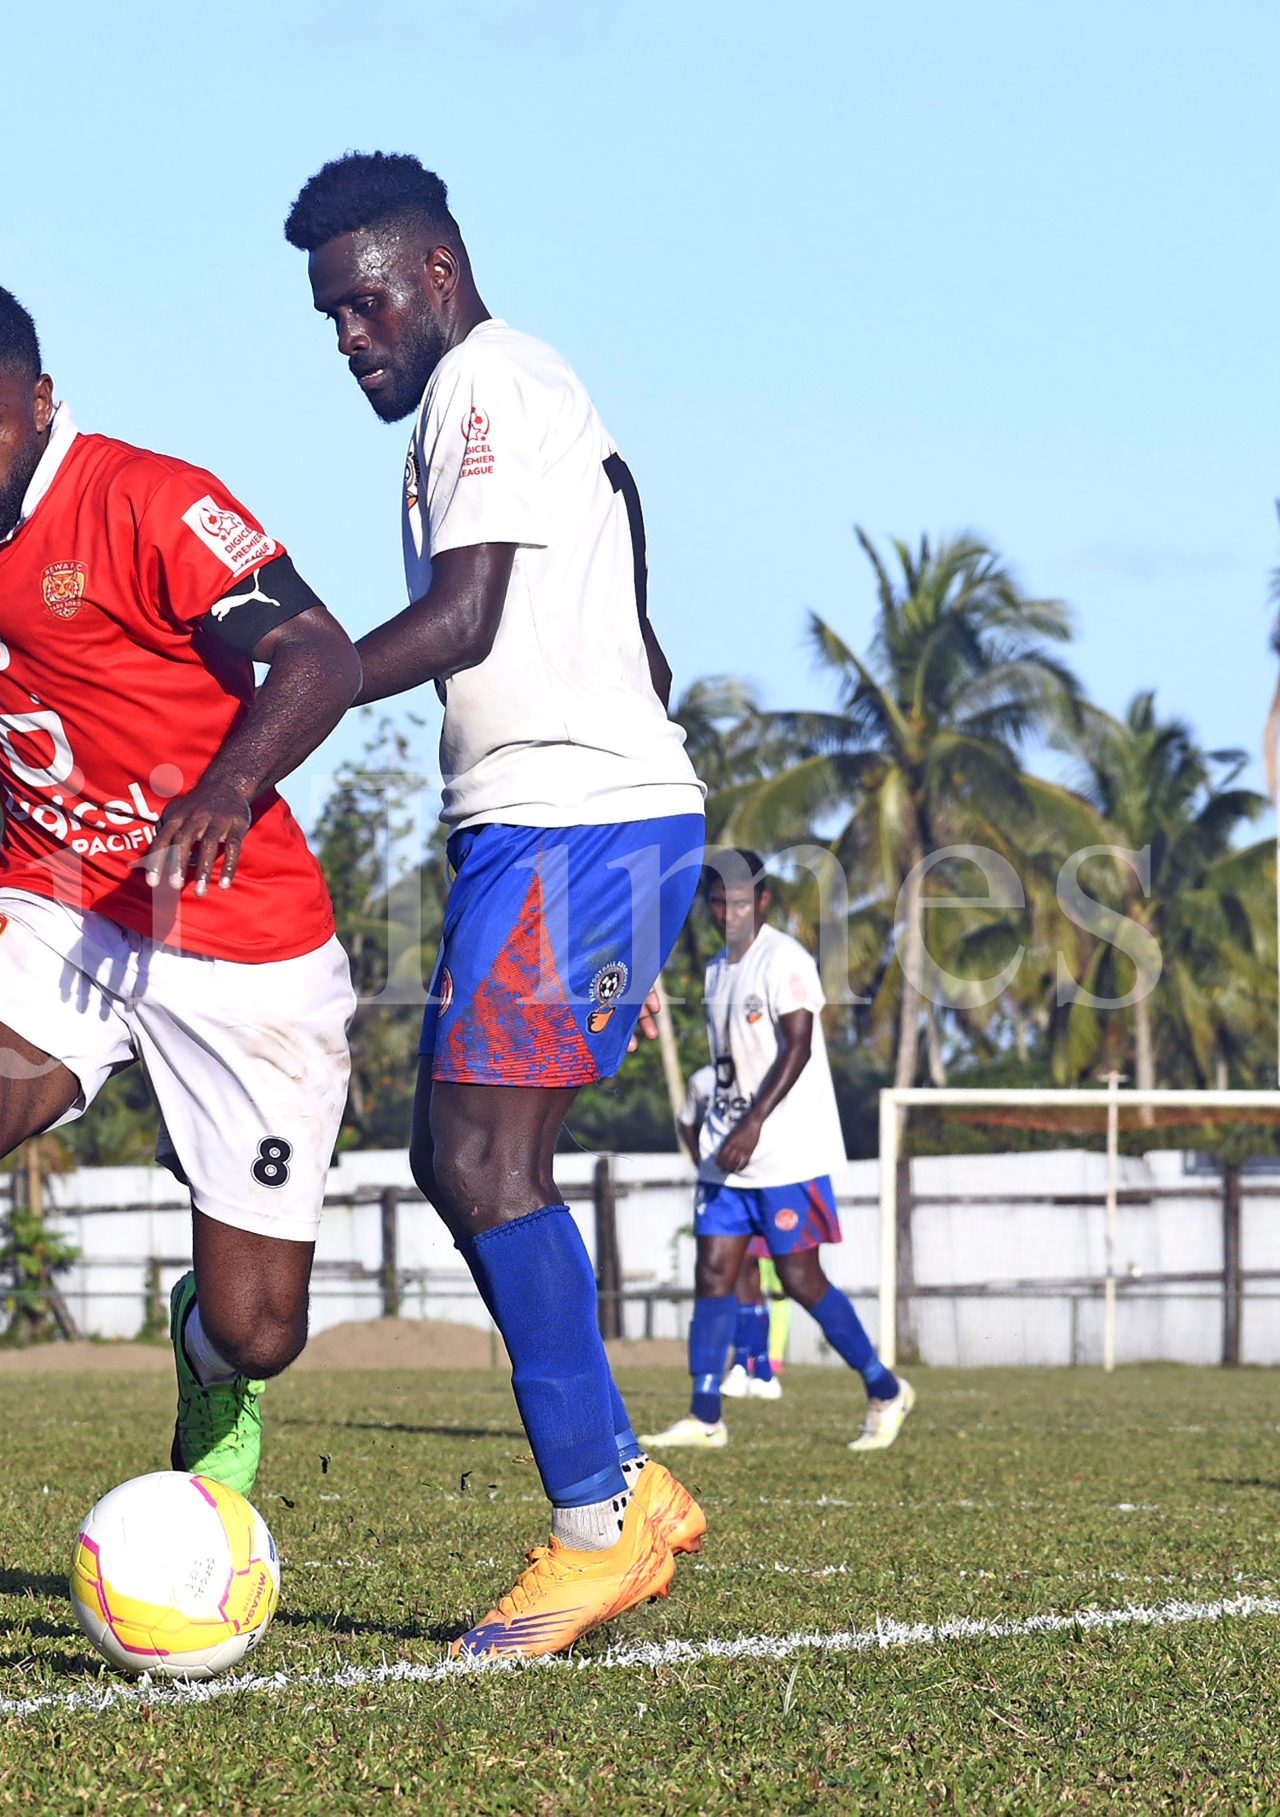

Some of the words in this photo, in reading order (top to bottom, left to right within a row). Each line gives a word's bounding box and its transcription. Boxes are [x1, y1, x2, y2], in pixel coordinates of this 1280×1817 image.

[224, 526, 253, 554] DIGICE
[72, 825, 157, 856] PACIFI
[251, 1136, 293, 1188] 8
